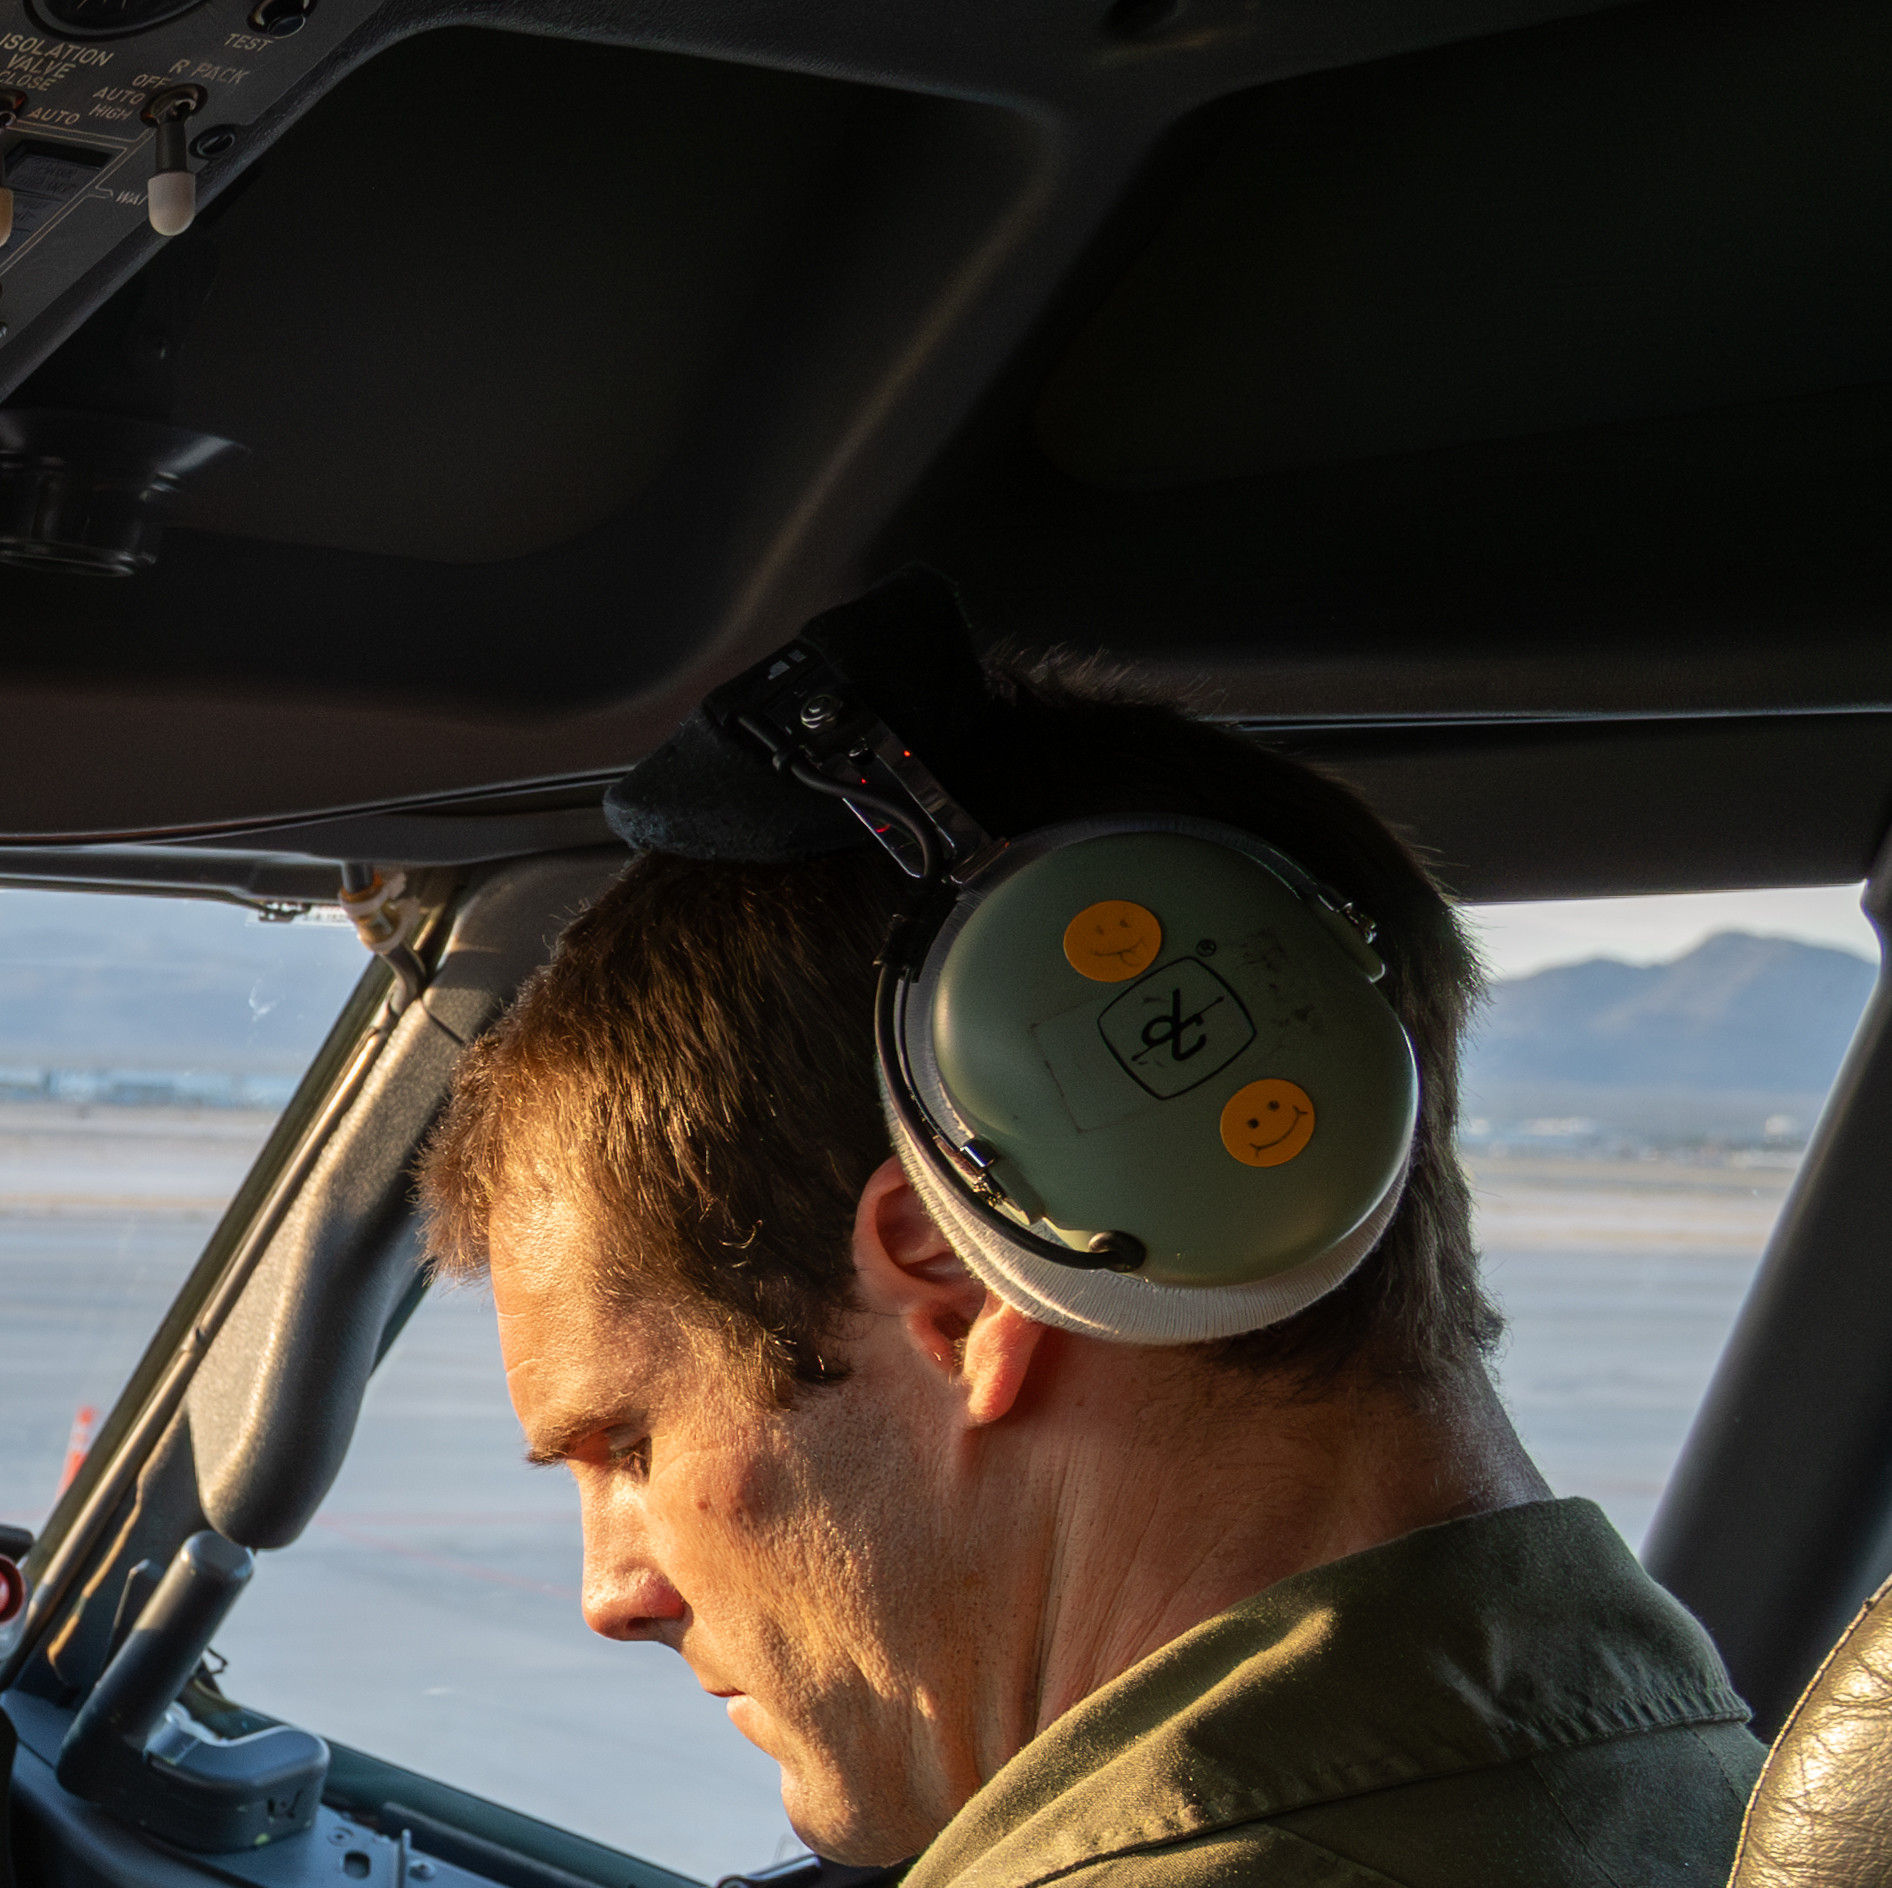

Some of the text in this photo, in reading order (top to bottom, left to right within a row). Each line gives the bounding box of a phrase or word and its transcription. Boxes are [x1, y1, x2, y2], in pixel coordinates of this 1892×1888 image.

[224, 33, 274, 53] TEST
[5, 55, 76, 80] VALVE
[192, 63, 251, 85] PACK
[93, 87, 146, 105] AUTO
[27, 107, 81, 125] AUTO
